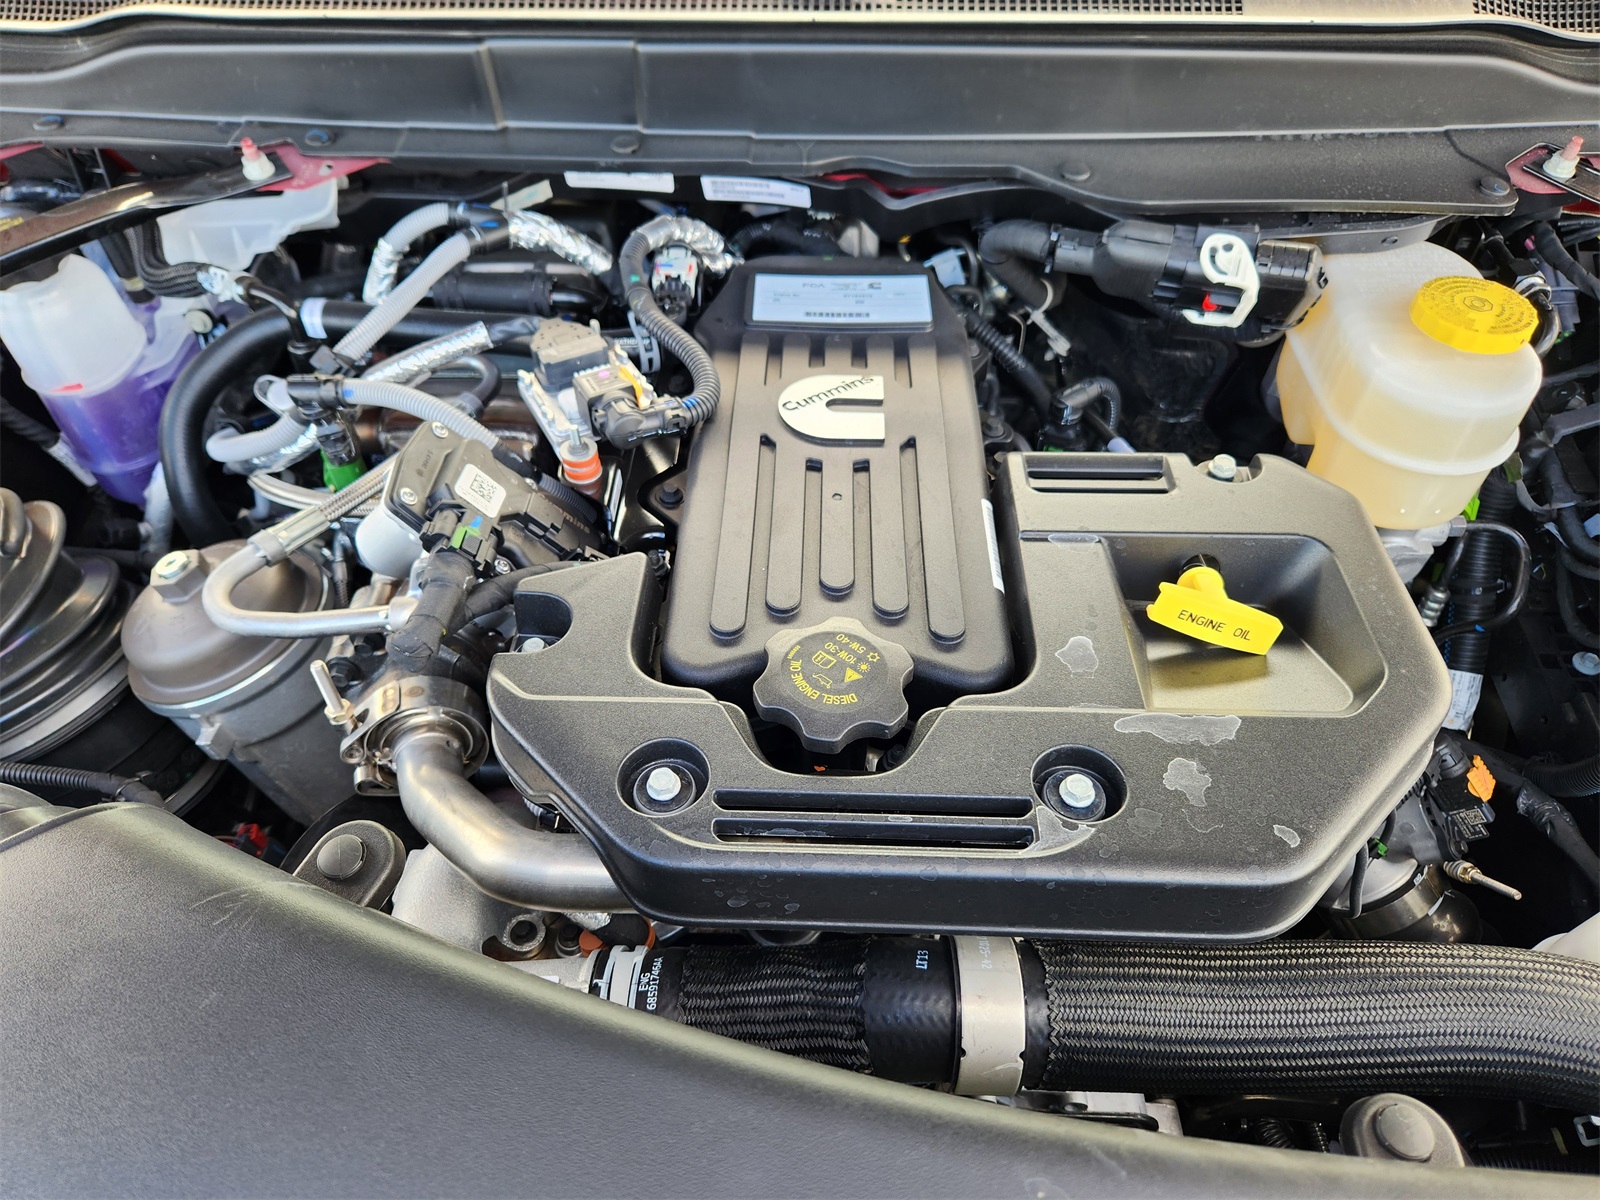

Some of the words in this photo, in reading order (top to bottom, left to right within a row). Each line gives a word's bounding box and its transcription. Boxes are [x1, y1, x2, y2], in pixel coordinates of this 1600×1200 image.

[782, 376, 874, 411] Cummins
[1178, 610, 1226, 633] ENGINE
[1232, 627, 1251, 641] OIL
[824, 642, 858, 665] 10W-30
[836, 633, 867, 654] 5W-40
[790, 660, 802, 672] OIL
[791, 672, 821, 700] ENGINE
[821, 693, 858, 705] DIESEL
[639, 972, 650, 992] ENG
